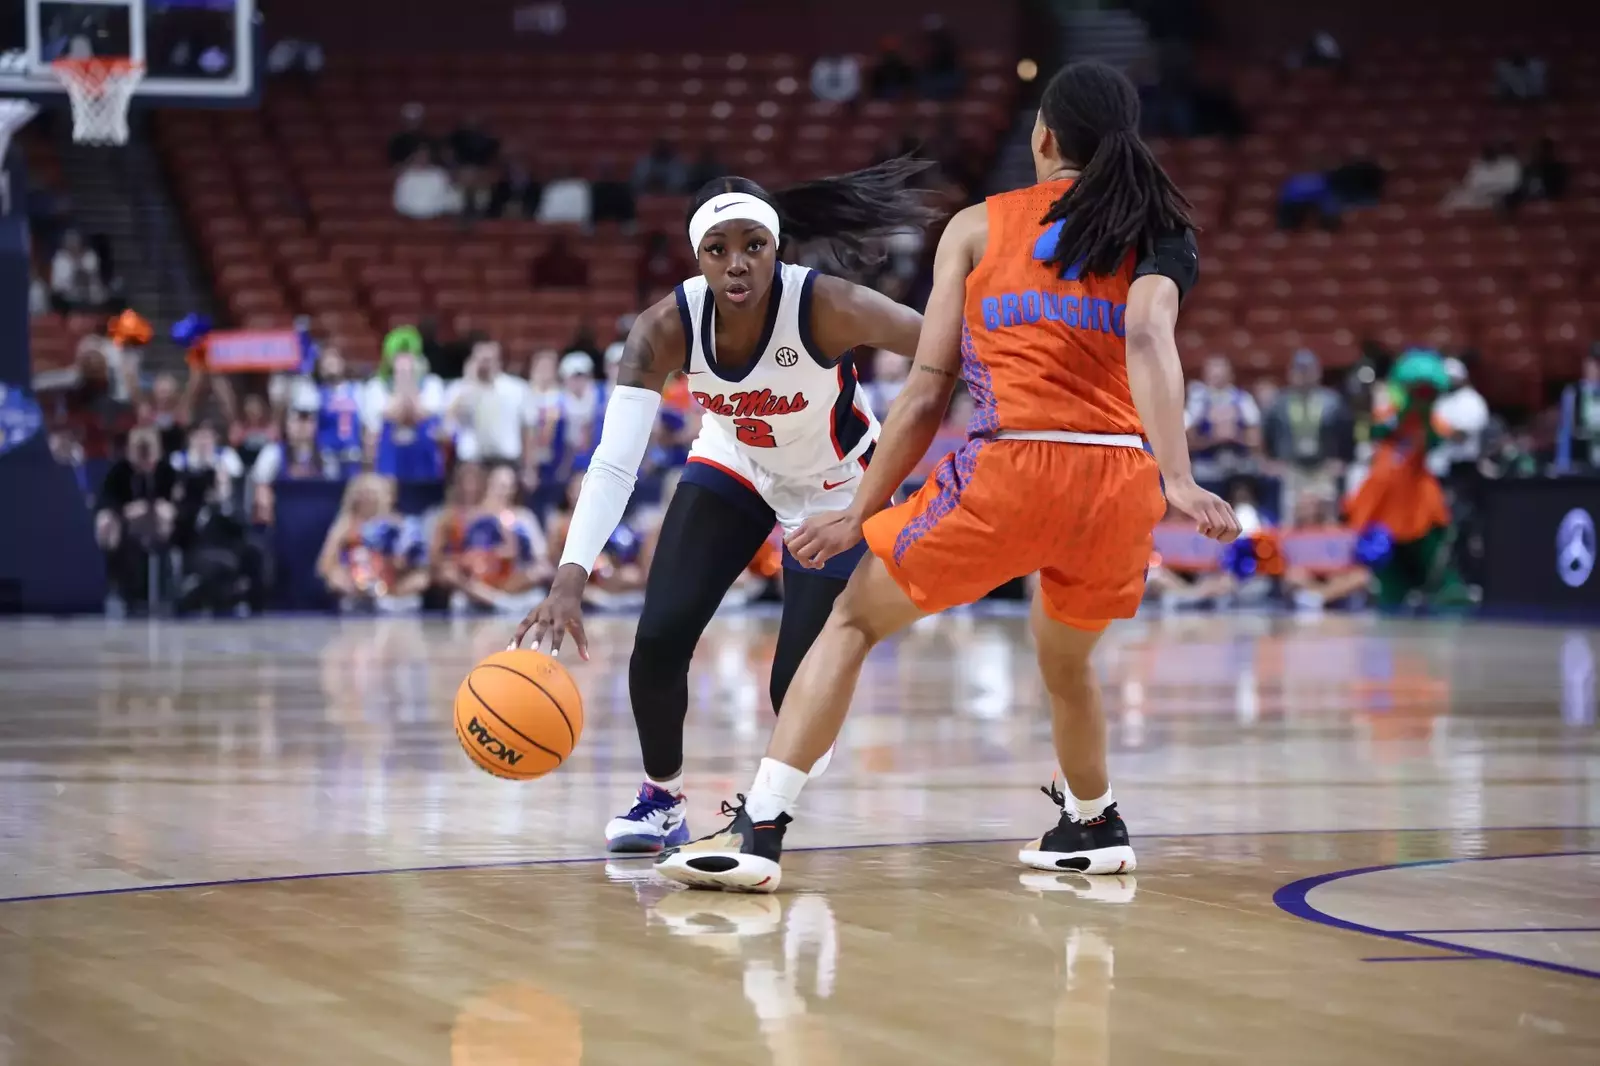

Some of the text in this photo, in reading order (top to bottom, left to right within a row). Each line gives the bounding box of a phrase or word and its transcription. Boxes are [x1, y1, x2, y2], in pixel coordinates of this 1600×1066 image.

[776, 347, 798, 366] SEC
[729, 388, 809, 417] Miss
[732, 417, 777, 448] 2
[467, 716, 523, 765] NCAA
